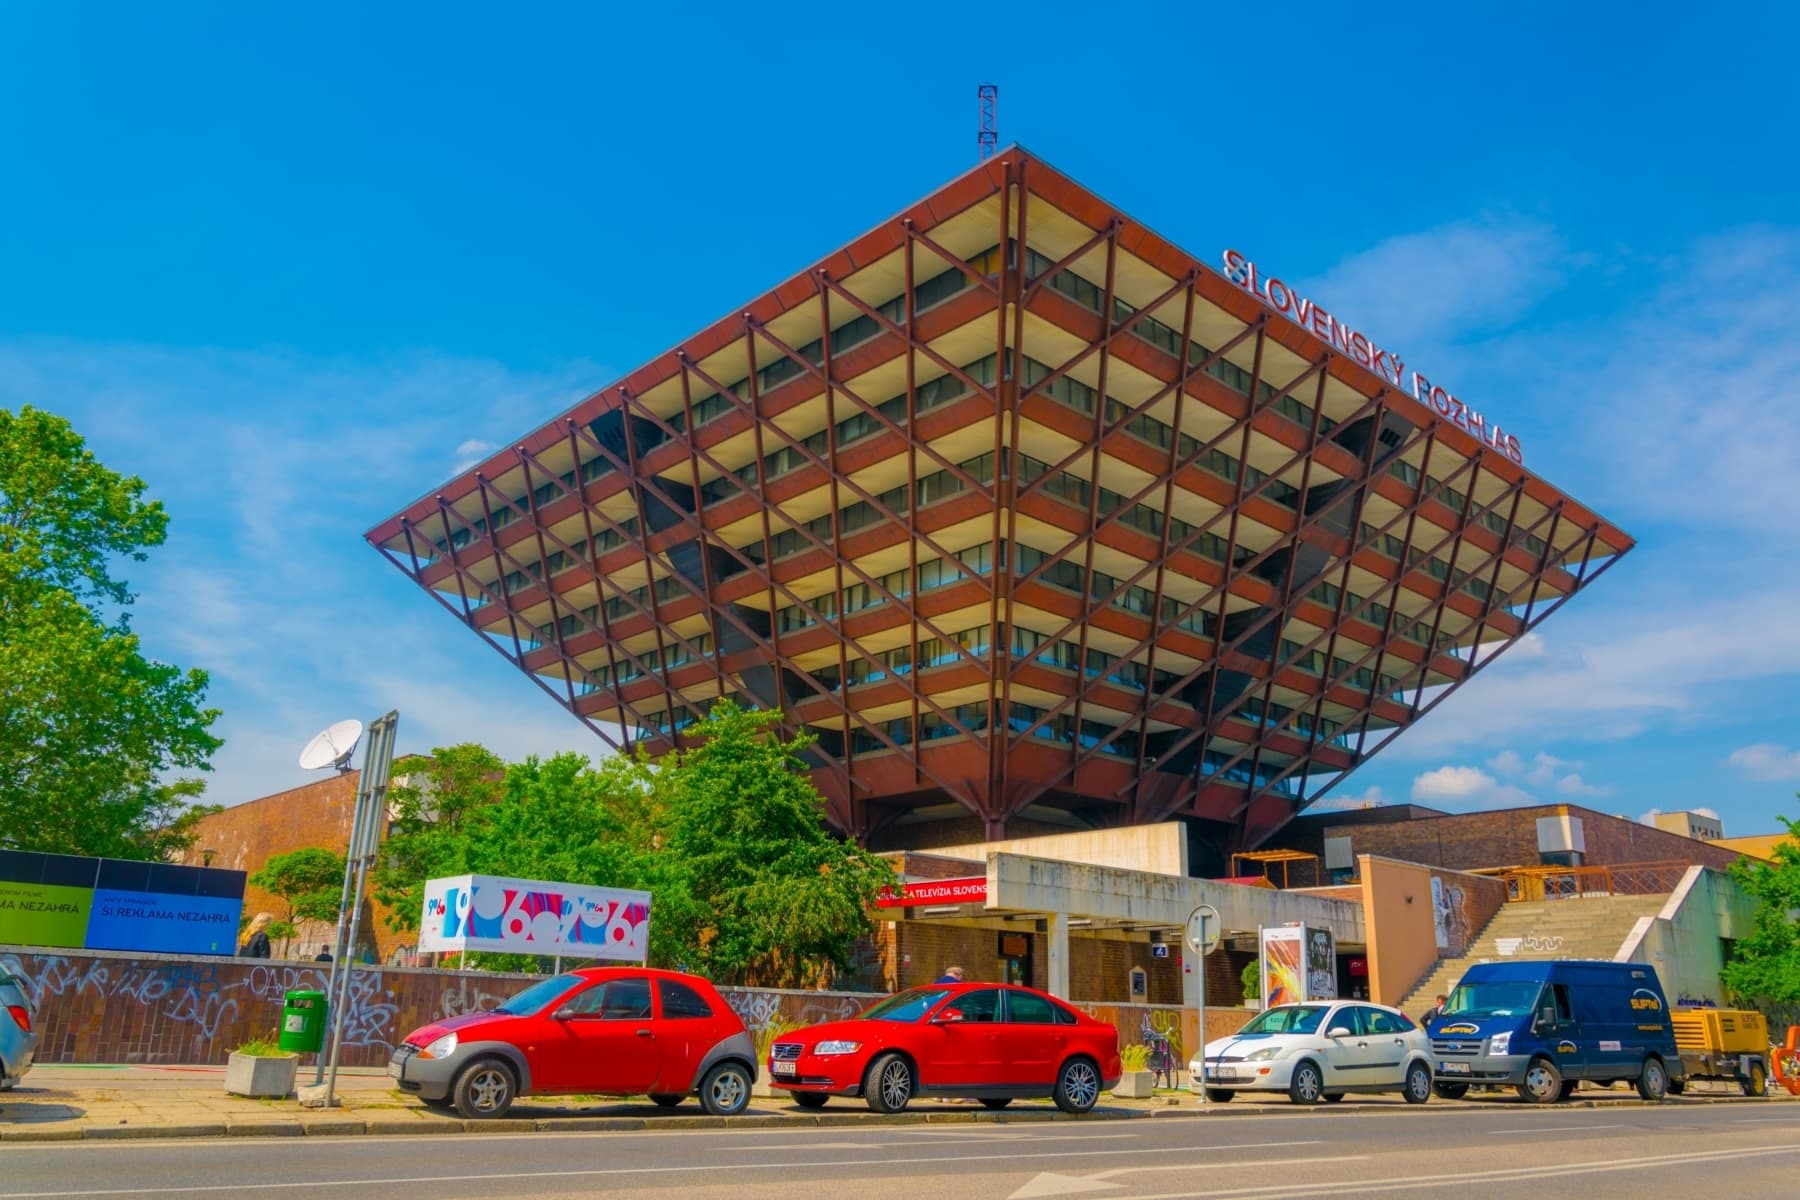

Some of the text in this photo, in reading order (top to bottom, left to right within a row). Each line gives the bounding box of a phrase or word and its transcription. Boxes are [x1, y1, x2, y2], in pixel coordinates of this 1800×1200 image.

[1223, 250, 1523, 464] SLOVENSKÝ ROZHLAS
[19, 901, 79, 914] NEZAHRÁ
[102, 906, 231, 923] SI REKLAMA NEZAHRÁ
